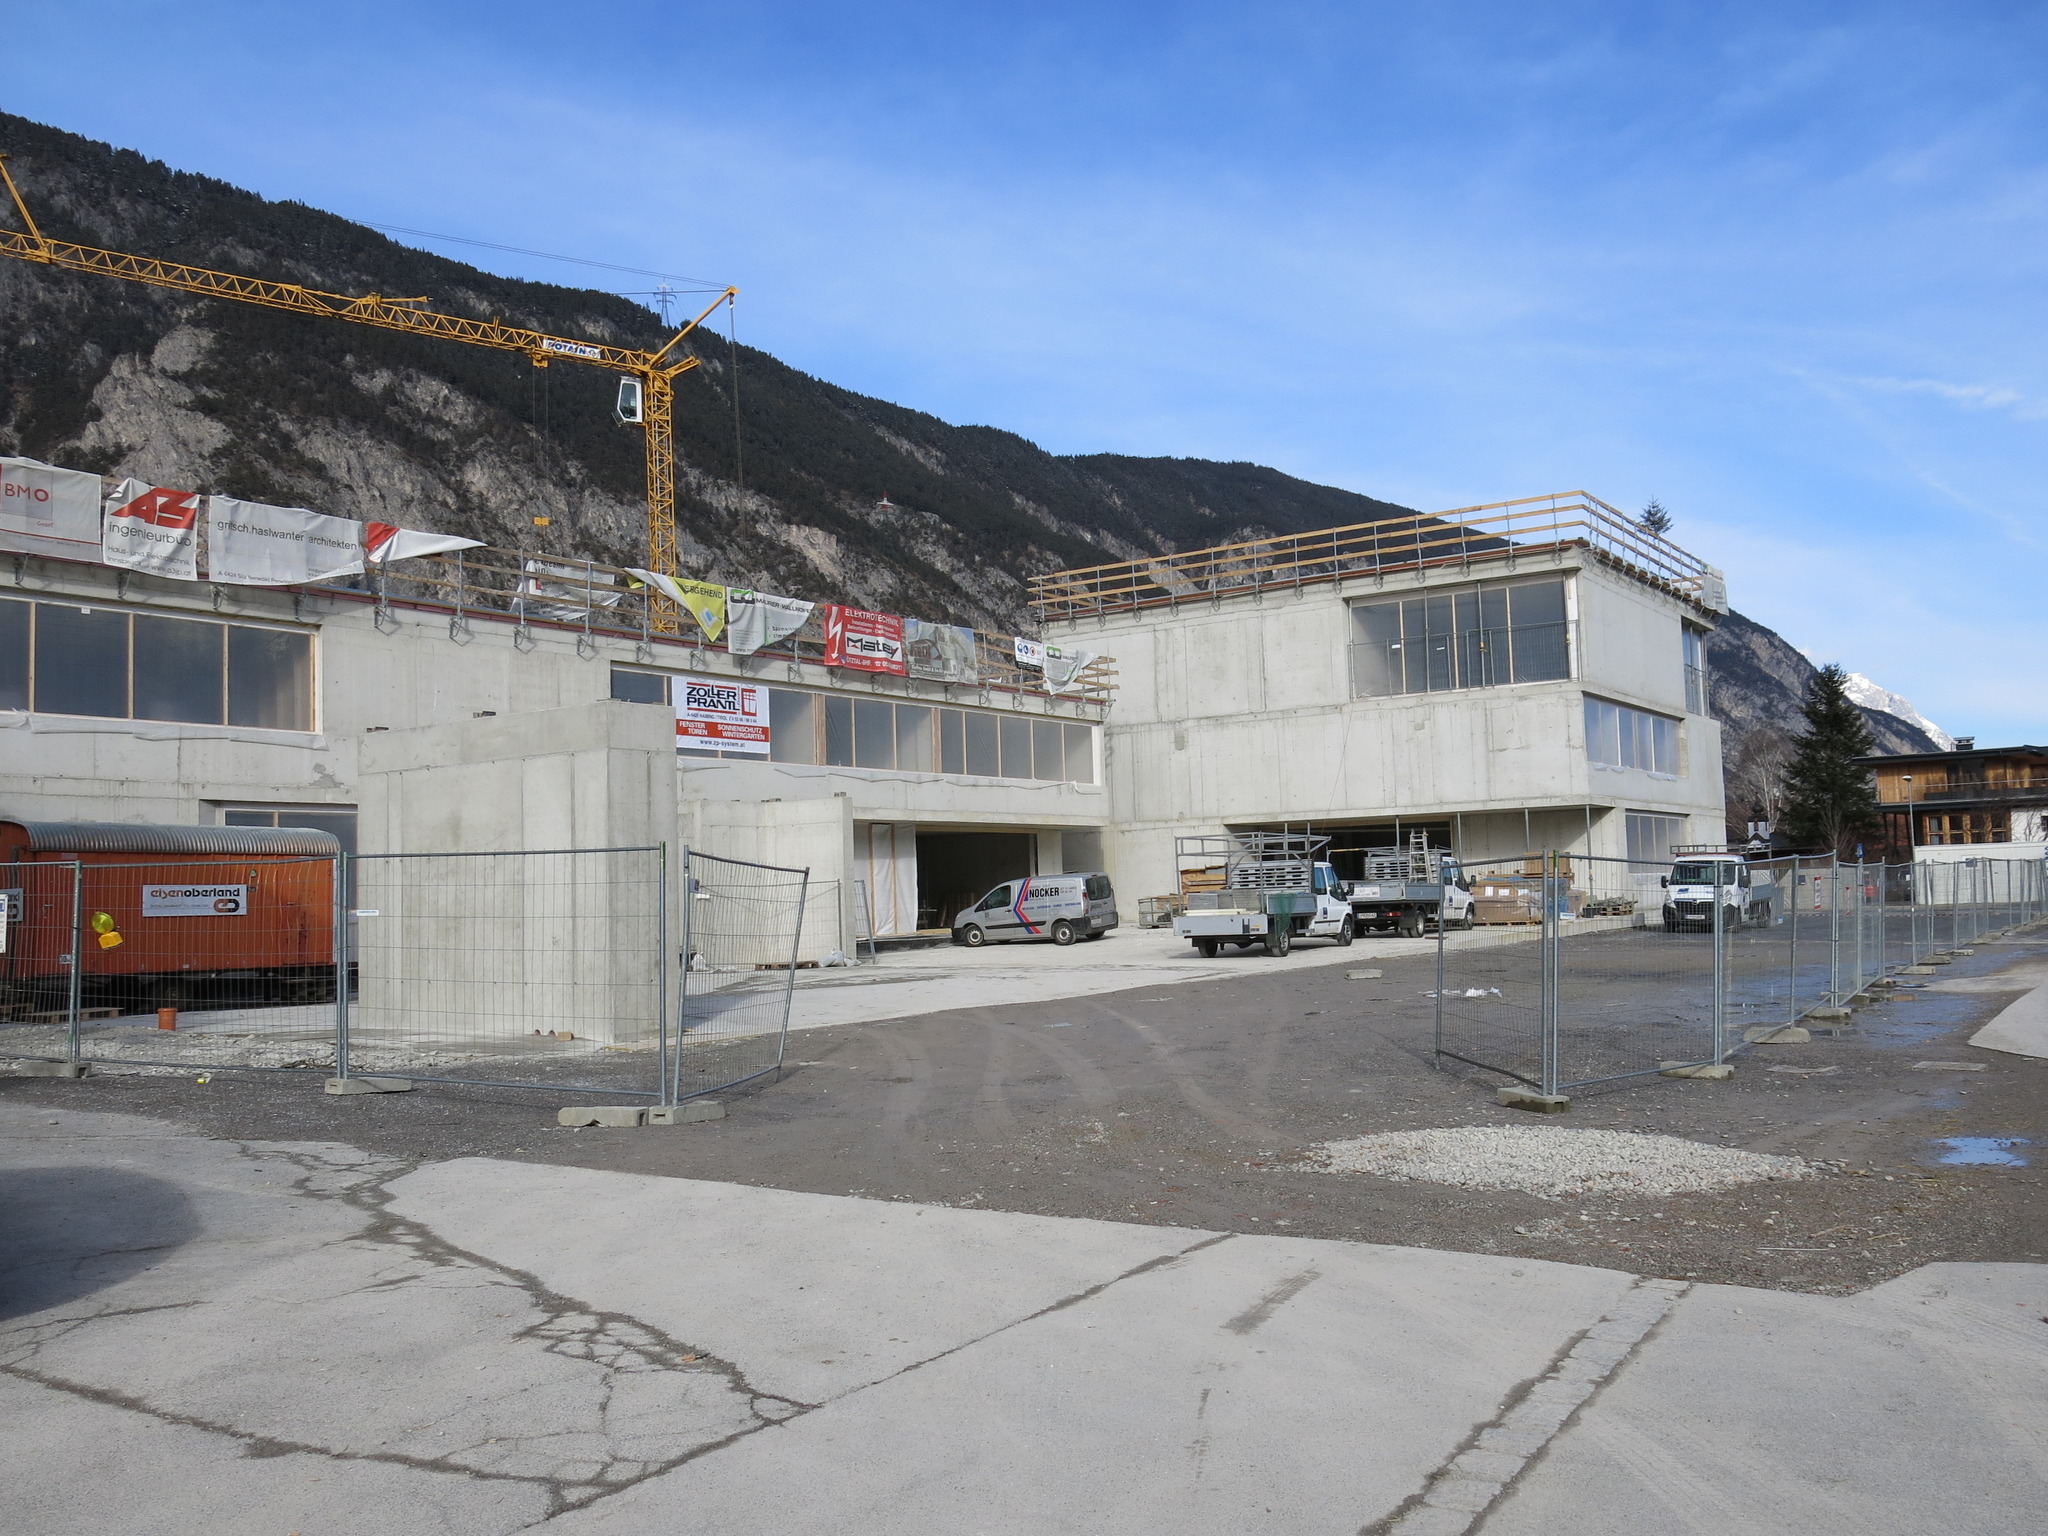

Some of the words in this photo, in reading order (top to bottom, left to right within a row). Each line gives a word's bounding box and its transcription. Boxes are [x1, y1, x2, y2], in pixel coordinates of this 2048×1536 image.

[5, 483, 49, 502] BMO
[109, 521, 192, 547] ingenieurbüro
[217, 519, 304, 542] gritsch.haslwanter
[308, 535, 358, 551] architekten
[845, 608, 899, 627] ELEKTROTECHNIK
[847, 636, 899, 659] Matey
[686, 684, 737, 700] ZOLLER
[687, 696, 741, 711] PRANTL
[679, 720, 706, 729] FENSTER
[717, 724, 763, 734] SONNENSCHUTZ
[150, 887, 240, 899] eisenoberland
[1029, 886, 1060, 899] NOCKER
